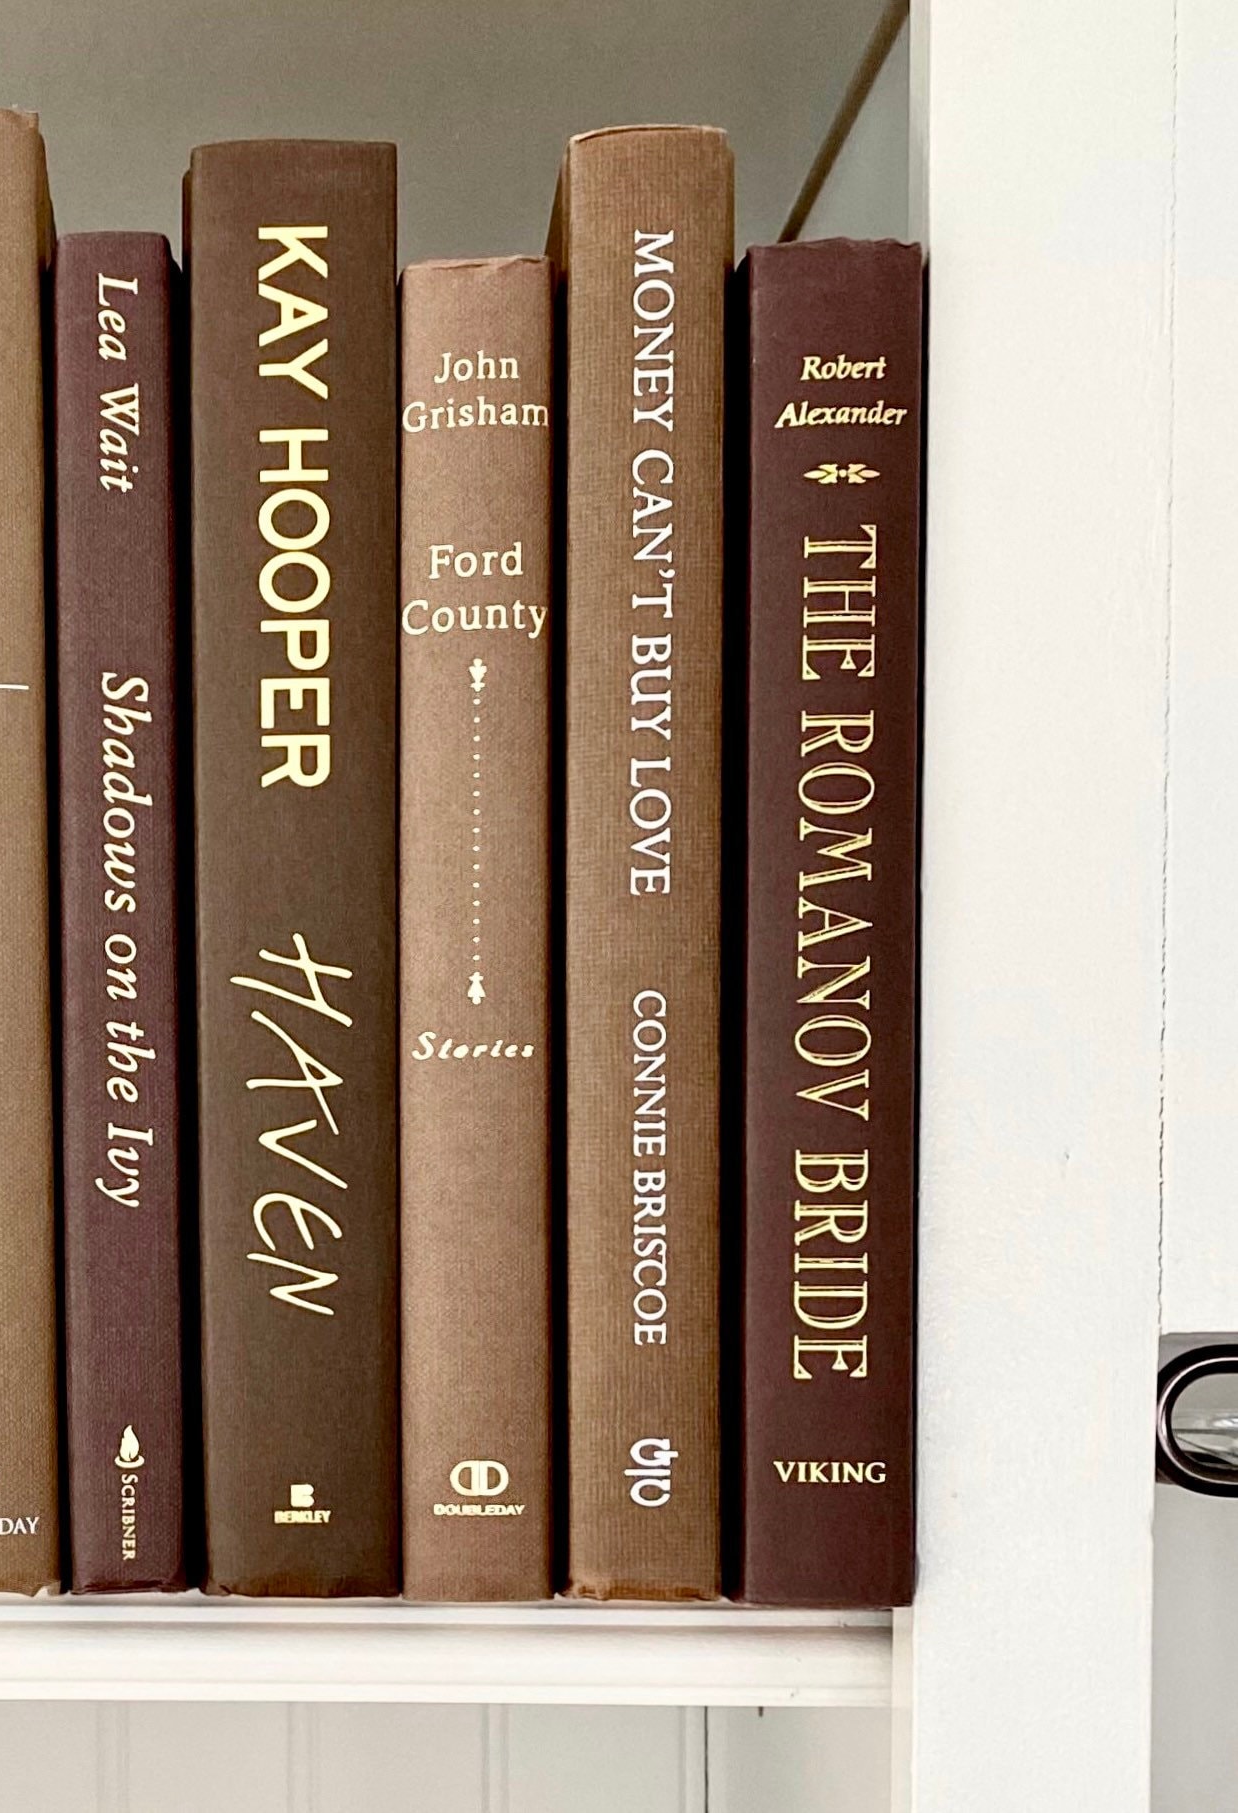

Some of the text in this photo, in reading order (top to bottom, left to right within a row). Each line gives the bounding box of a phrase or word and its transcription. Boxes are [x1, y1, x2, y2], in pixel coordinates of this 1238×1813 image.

[97, 272, 140, 493] Lea Wait
[433, 349, 519, 384] John
[800, 354, 887, 381] Robert
[402, 395, 548, 433] Grisham
[774, 400, 908, 429] Alexander
[258, 225, 331, 788] KAY HOOPER
[428, 541, 524, 580] Ford
[629, 229, 676, 896] MONEY CAN'T BUY LOVE
[402, 599, 546, 639] County
[95, 671, 155, 1208] Shadows on the Ivy
[793, 524, 877, 1380] THE ROMANOV BRIDE
[411, 1031, 534, 1061] Stories
[229, 932, 353, 1316] HAVEN
[632, 990, 667, 1346] CONNIE BRISCOE
[773, 1460, 886, 1484] VIKING
[121, 1474, 139, 1561] SCRIBNER
[433, 1503, 525, 1516] DOUBLEDAY
